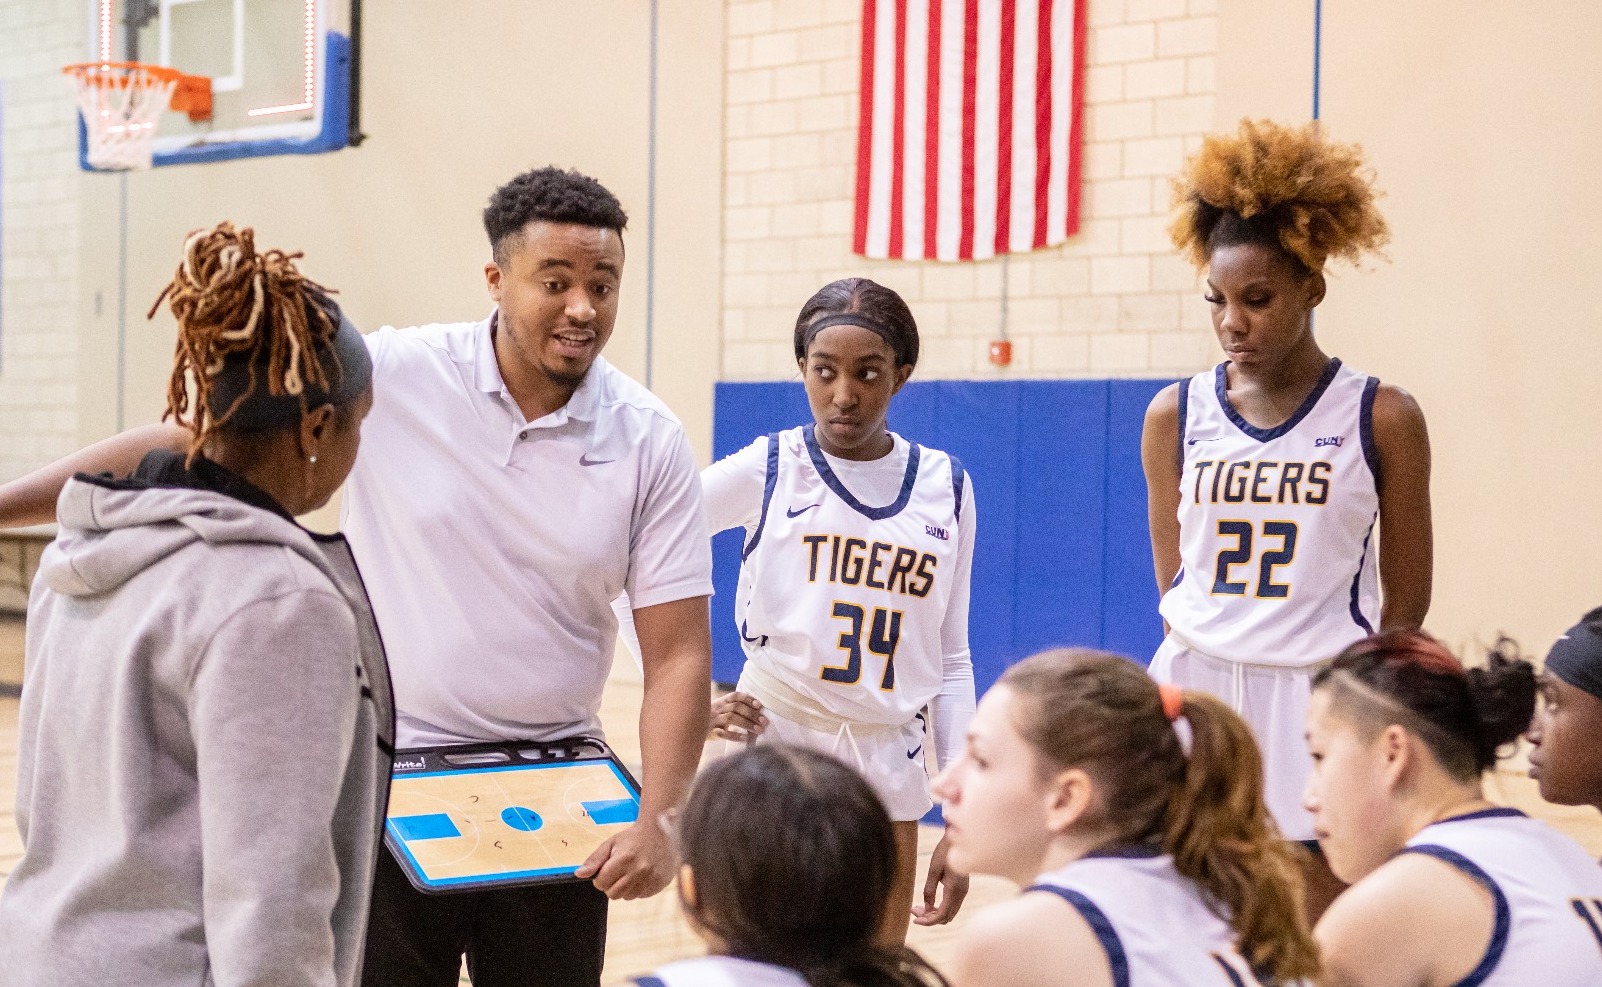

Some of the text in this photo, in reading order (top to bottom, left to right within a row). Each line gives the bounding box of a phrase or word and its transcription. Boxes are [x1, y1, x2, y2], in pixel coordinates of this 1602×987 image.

[1193, 460, 1332, 506] TIGERS
[803, 534, 938, 598] TIGERS
[1210, 519, 1298, 600] 22
[820, 600, 904, 692] 34
